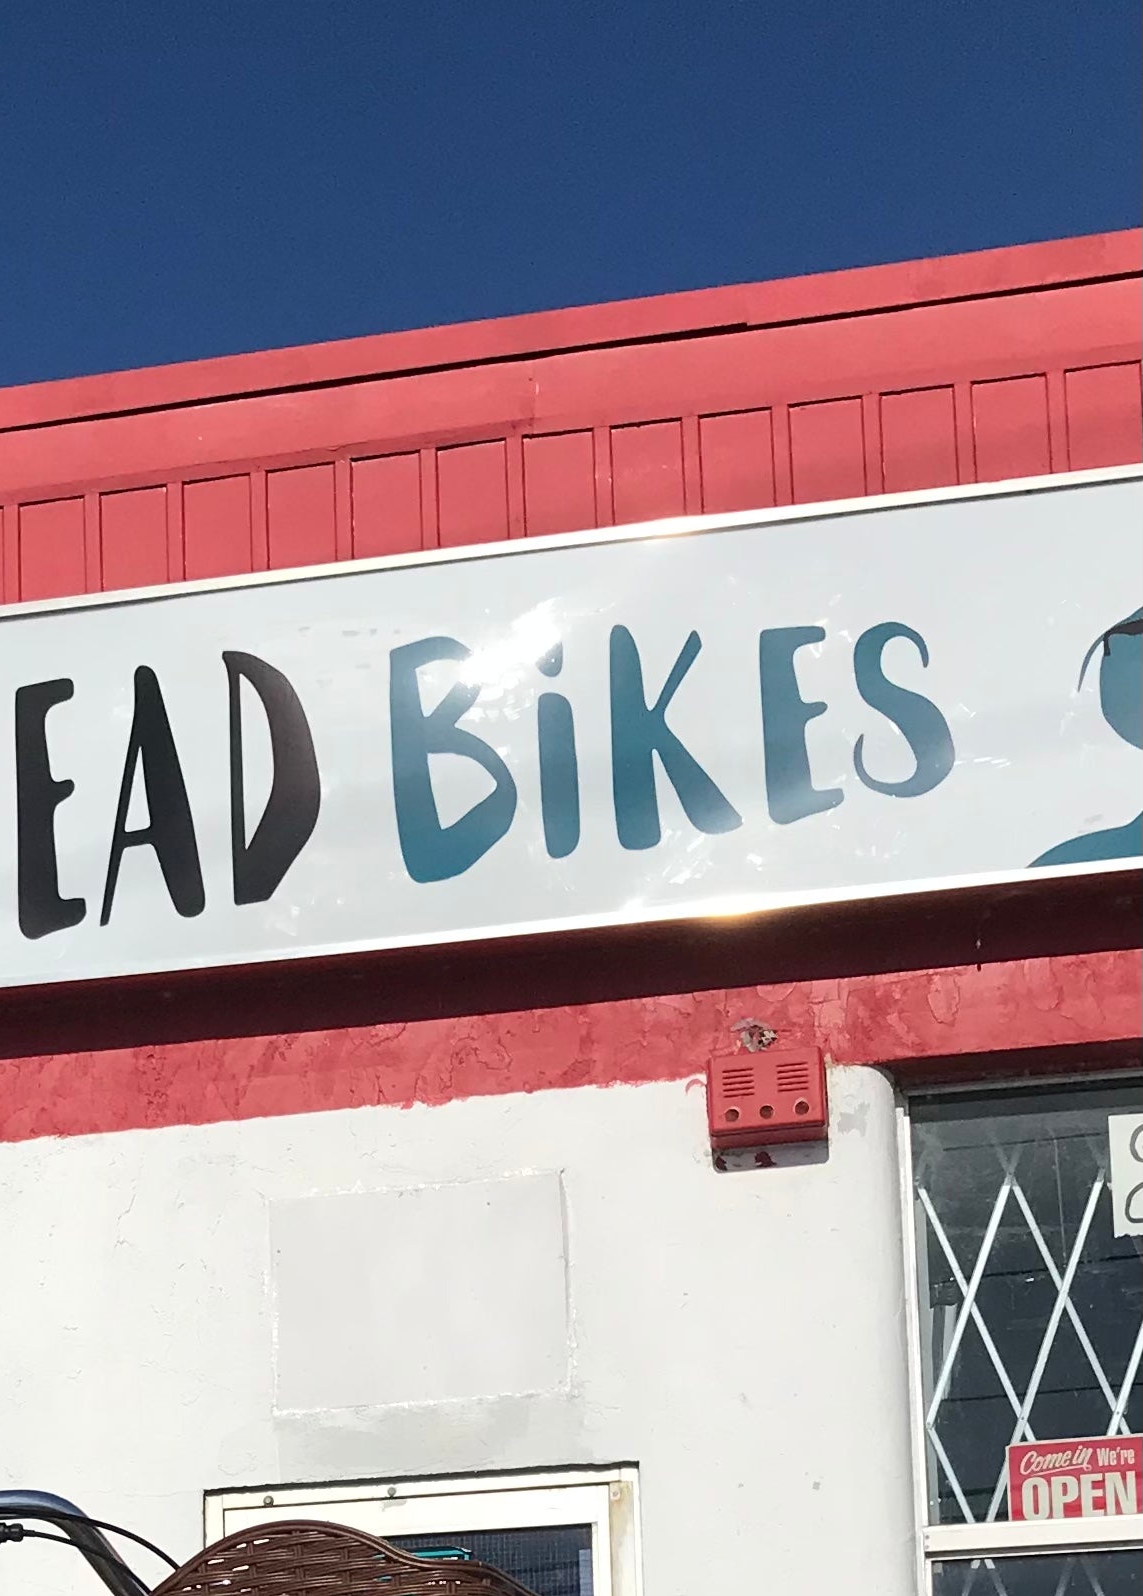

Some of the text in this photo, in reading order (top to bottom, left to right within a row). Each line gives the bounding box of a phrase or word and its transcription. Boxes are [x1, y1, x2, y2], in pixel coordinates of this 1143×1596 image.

[1019, 1445, 1135, 1476] Come in We're
[1021, 1470, 1138, 1520] OPEN
